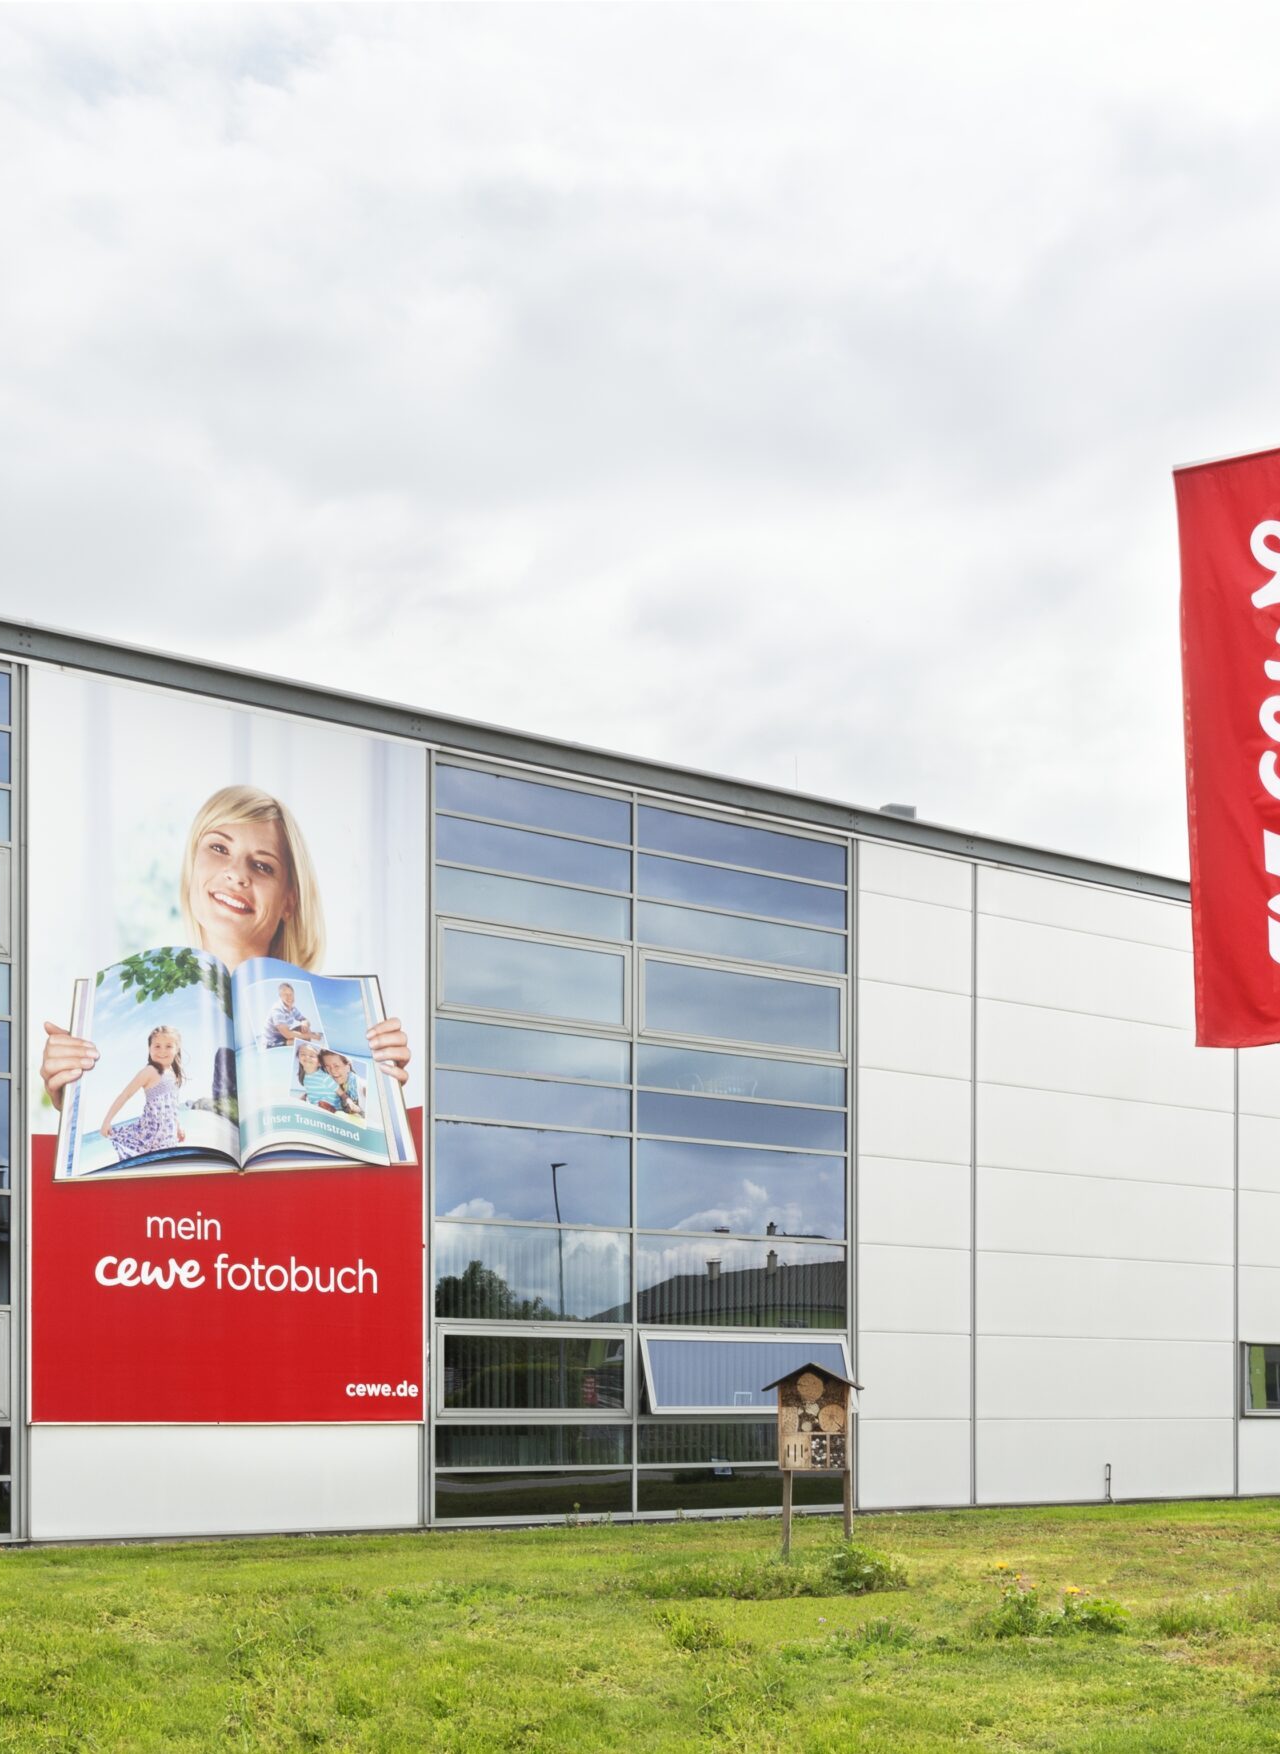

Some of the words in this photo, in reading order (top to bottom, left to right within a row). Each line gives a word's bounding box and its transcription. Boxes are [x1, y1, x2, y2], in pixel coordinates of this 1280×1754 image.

[294, 1113, 360, 1142] Traumstrand
[146, 1211, 221, 1241] mein
[94, 1255, 206, 1290] cewe
[213, 1253, 378, 1294] fotobuch
[345, 1380, 419, 1398] cewe.de
